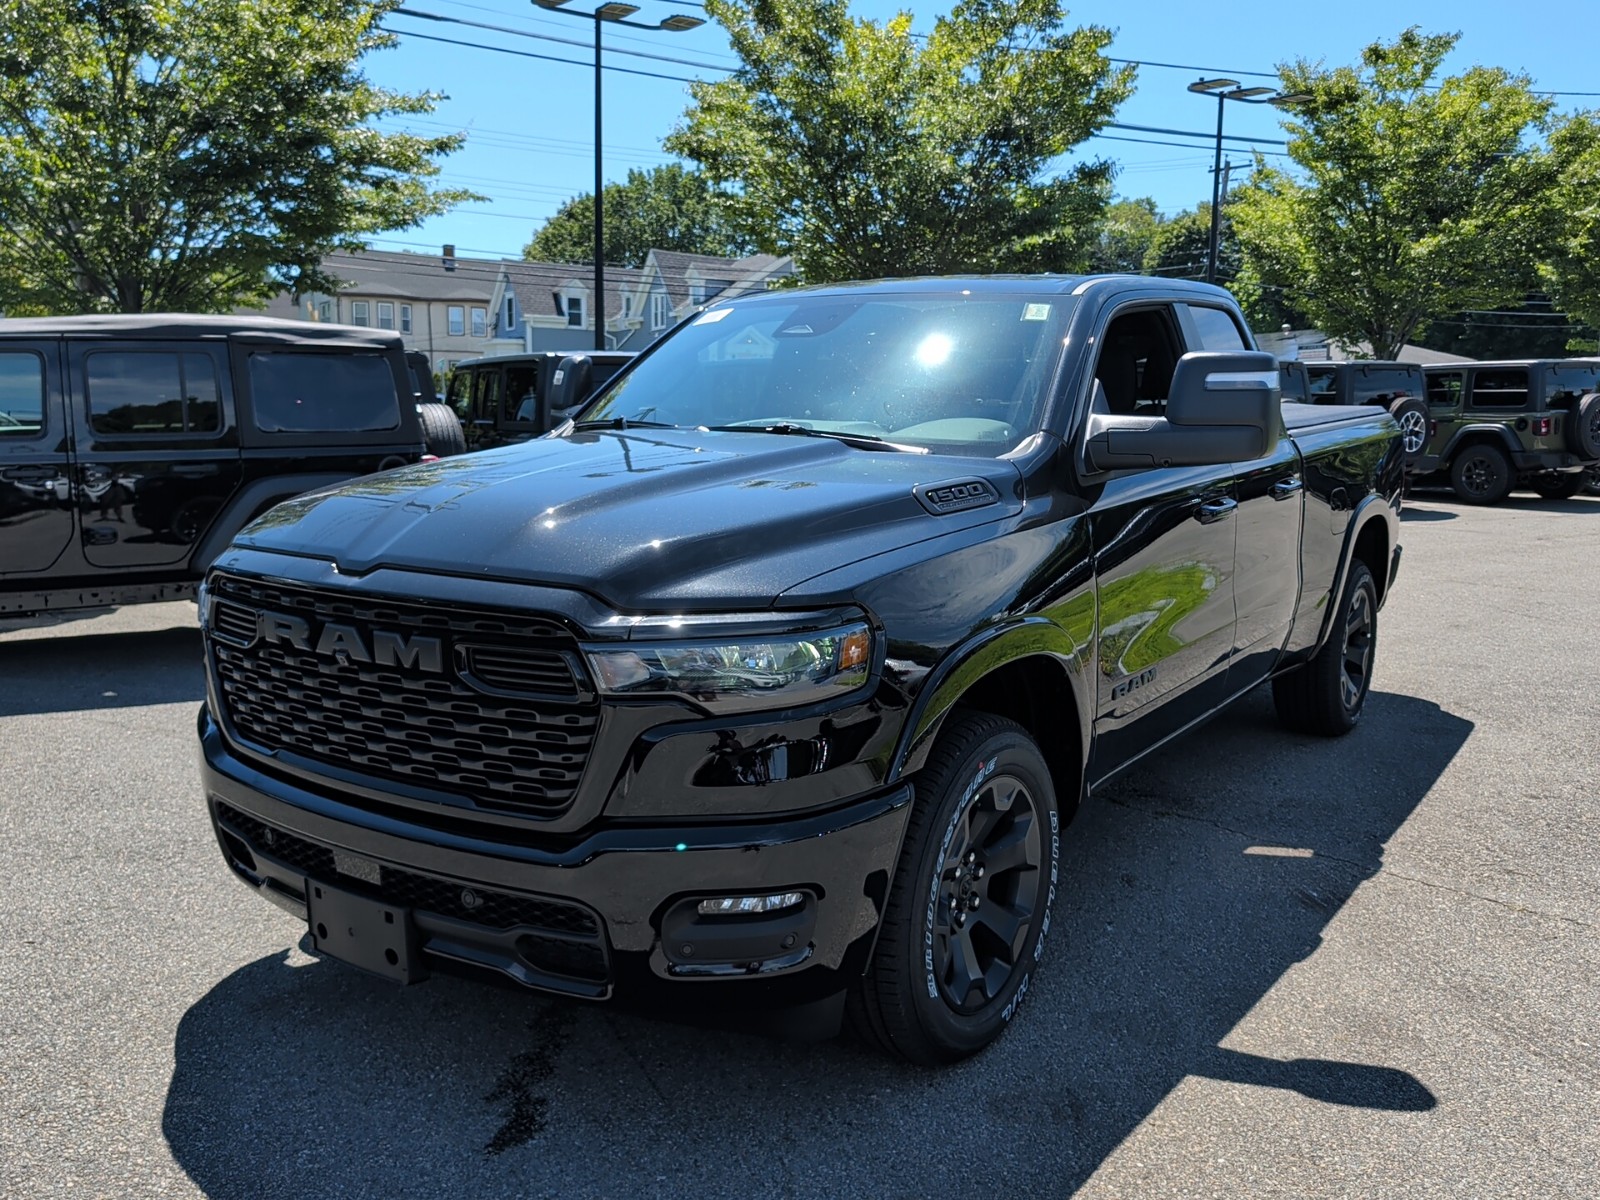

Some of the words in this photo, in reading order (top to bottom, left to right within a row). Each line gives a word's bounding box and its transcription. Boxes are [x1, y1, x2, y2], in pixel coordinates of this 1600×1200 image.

[927, 483, 985, 503] 1500
[259, 609, 443, 673] RAM
[1111, 667, 1157, 701] RAM
[925, 756, 998, 998] BRIDGESTONE
[1034, 810, 1060, 962] DUELER
